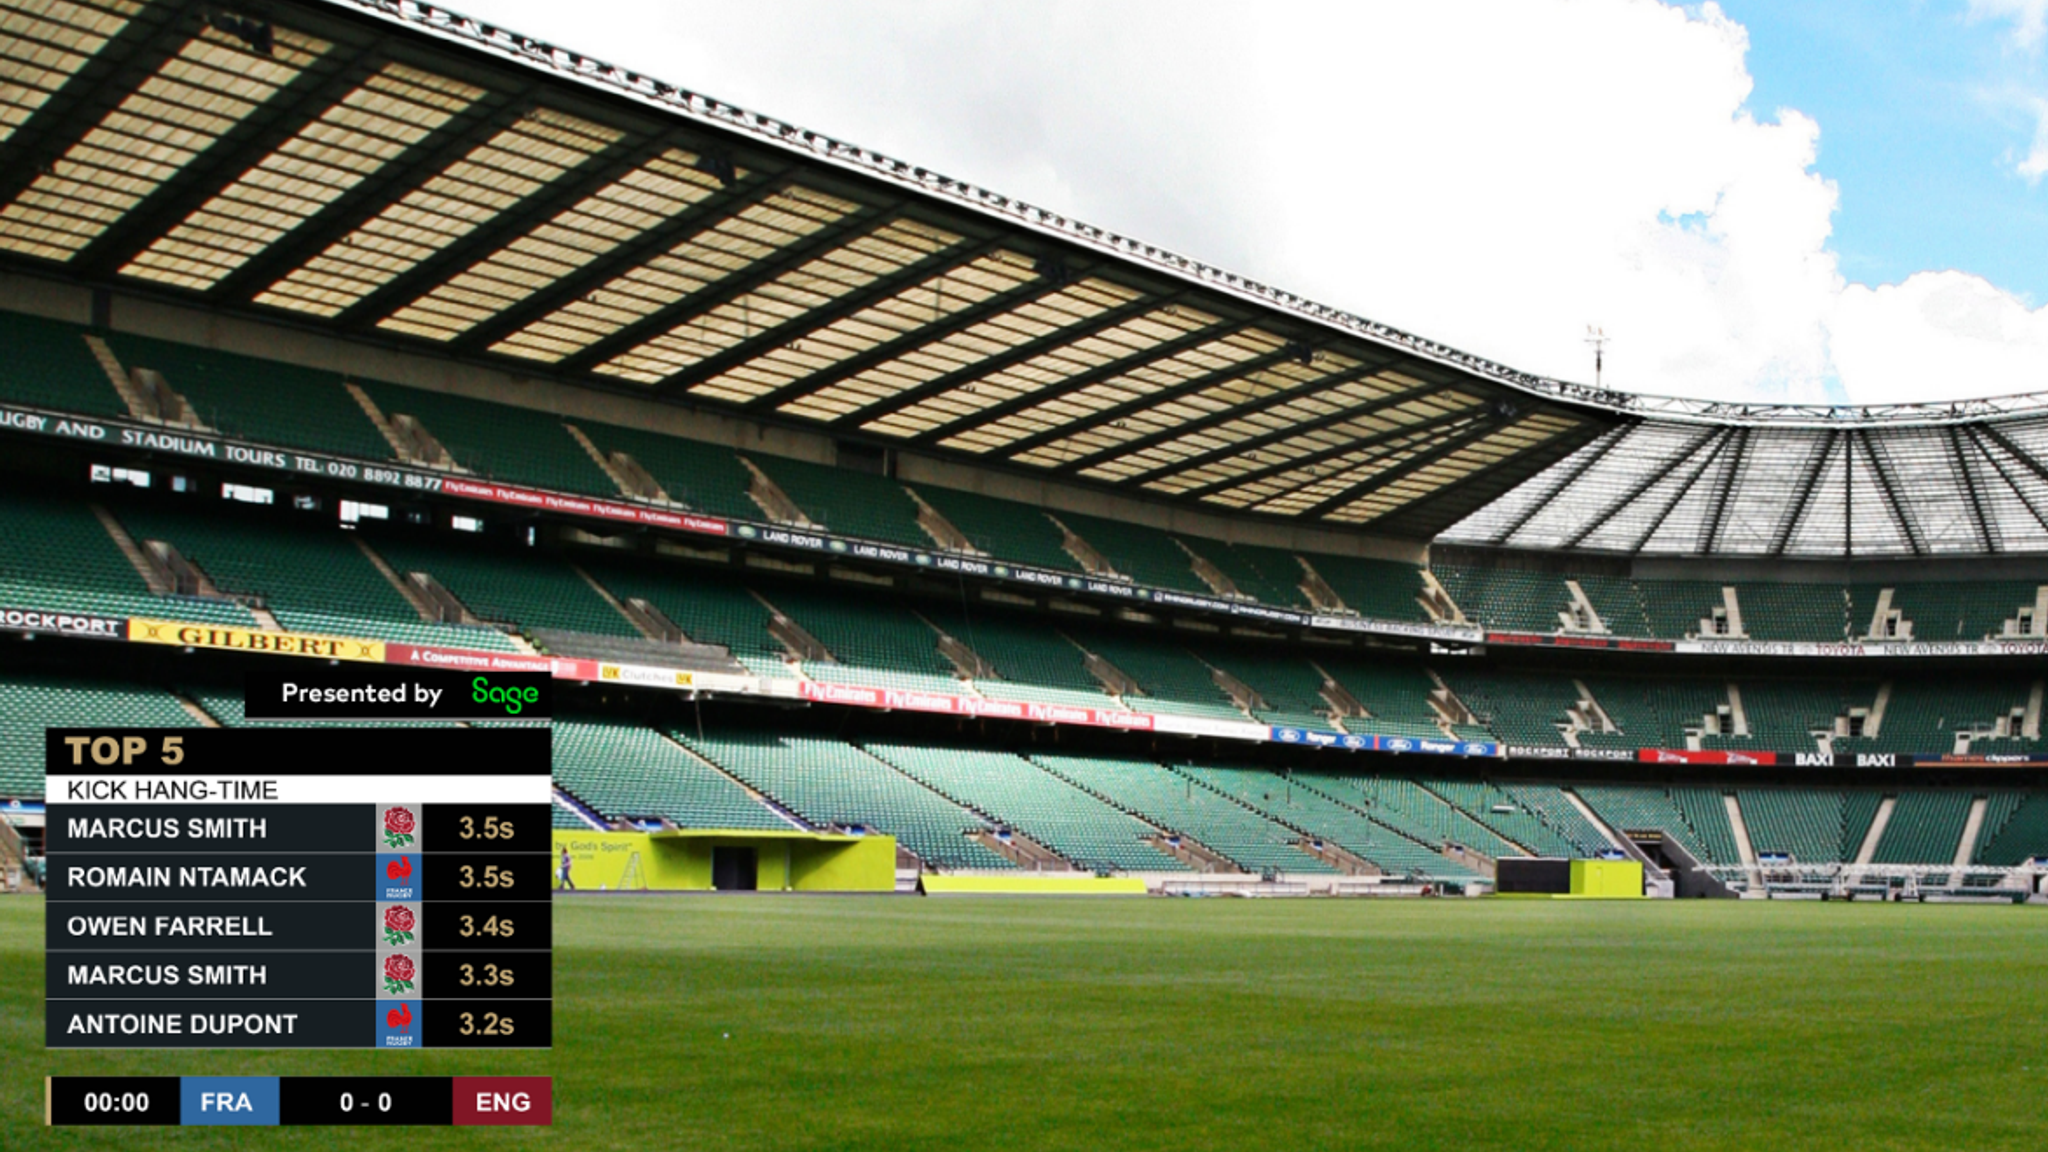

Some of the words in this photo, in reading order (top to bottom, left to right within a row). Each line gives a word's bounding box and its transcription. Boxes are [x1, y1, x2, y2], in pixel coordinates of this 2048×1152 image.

[55, 420, 105, 439] AND
[122, 429, 215, 456] STADIUM
[225, 445, 286, 467] TOURS
[328, 461, 356, 478] 020
[364, 467, 400, 484] 8892
[404, 475, 442, 491] 8877
[763, 530, 789, 543] LAND
[791, 534, 823, 548] ROVER
[854, 545, 878, 557] LAND
[879, 549, 909, 561] ROVER
[938, 558, 959, 570] LAND
[960, 562, 988, 574] ROVER
[1016, 570, 1036, 581] LAND
[1036, 573, 1062, 586] ROVER
[1088, 582, 1107, 593] LAND
[1109, 585, 1132, 596] ROVER
[178, 627, 344, 656] GILBERT
[411, 650, 420, 661] A
[1702, 643, 1729, 655] NEW
[1733, 643, 1778, 655] AVENSIS
[1816, 643, 1866, 656] TOYOTA
[1884, 644, 1909, 655] NEW
[1914, 643, 1961, 655] AVENSIS
[1509, 747, 1569, 758] ROCKPORT
[1575, 749, 1634, 760] ROCKPORT
[1795, 753, 1834, 766] BAXI
[1857, 754, 1895, 767] BAXI
